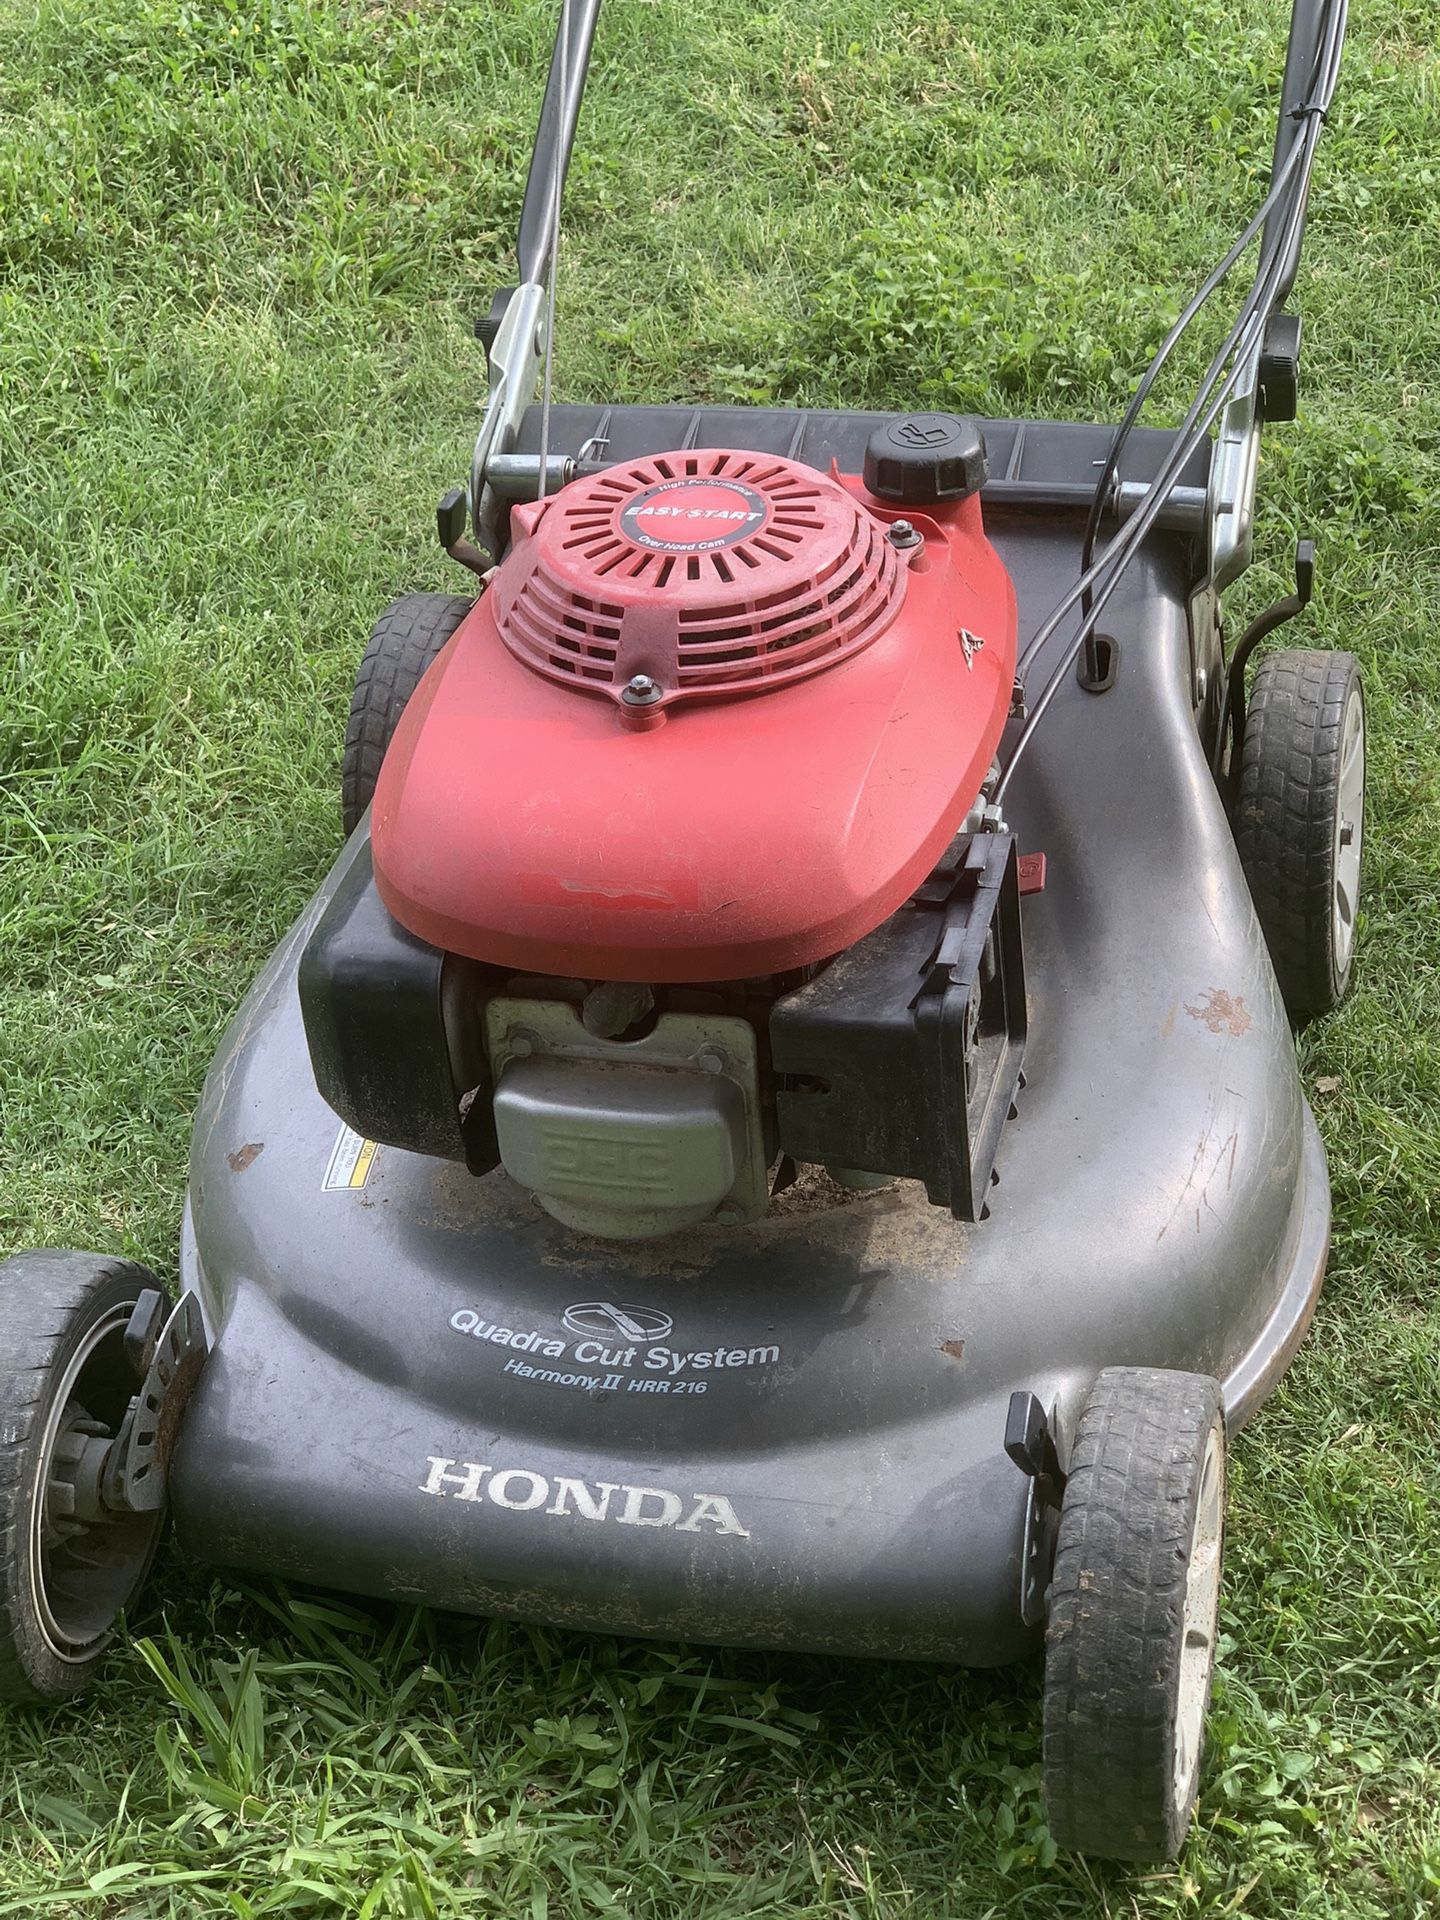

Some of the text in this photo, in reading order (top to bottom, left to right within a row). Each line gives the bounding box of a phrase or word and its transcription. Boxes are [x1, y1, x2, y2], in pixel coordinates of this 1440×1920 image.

[659, 479, 753, 496] High Performance
[625, 506, 763, 522] EASY START
[638, 534, 725, 551] Over Head Cam
[449, 1309, 780, 1375] Quadra Cut System
[503, 1358, 708, 1394] Harmony II HRR 216
[418, 1455, 750, 1537] HONDA
